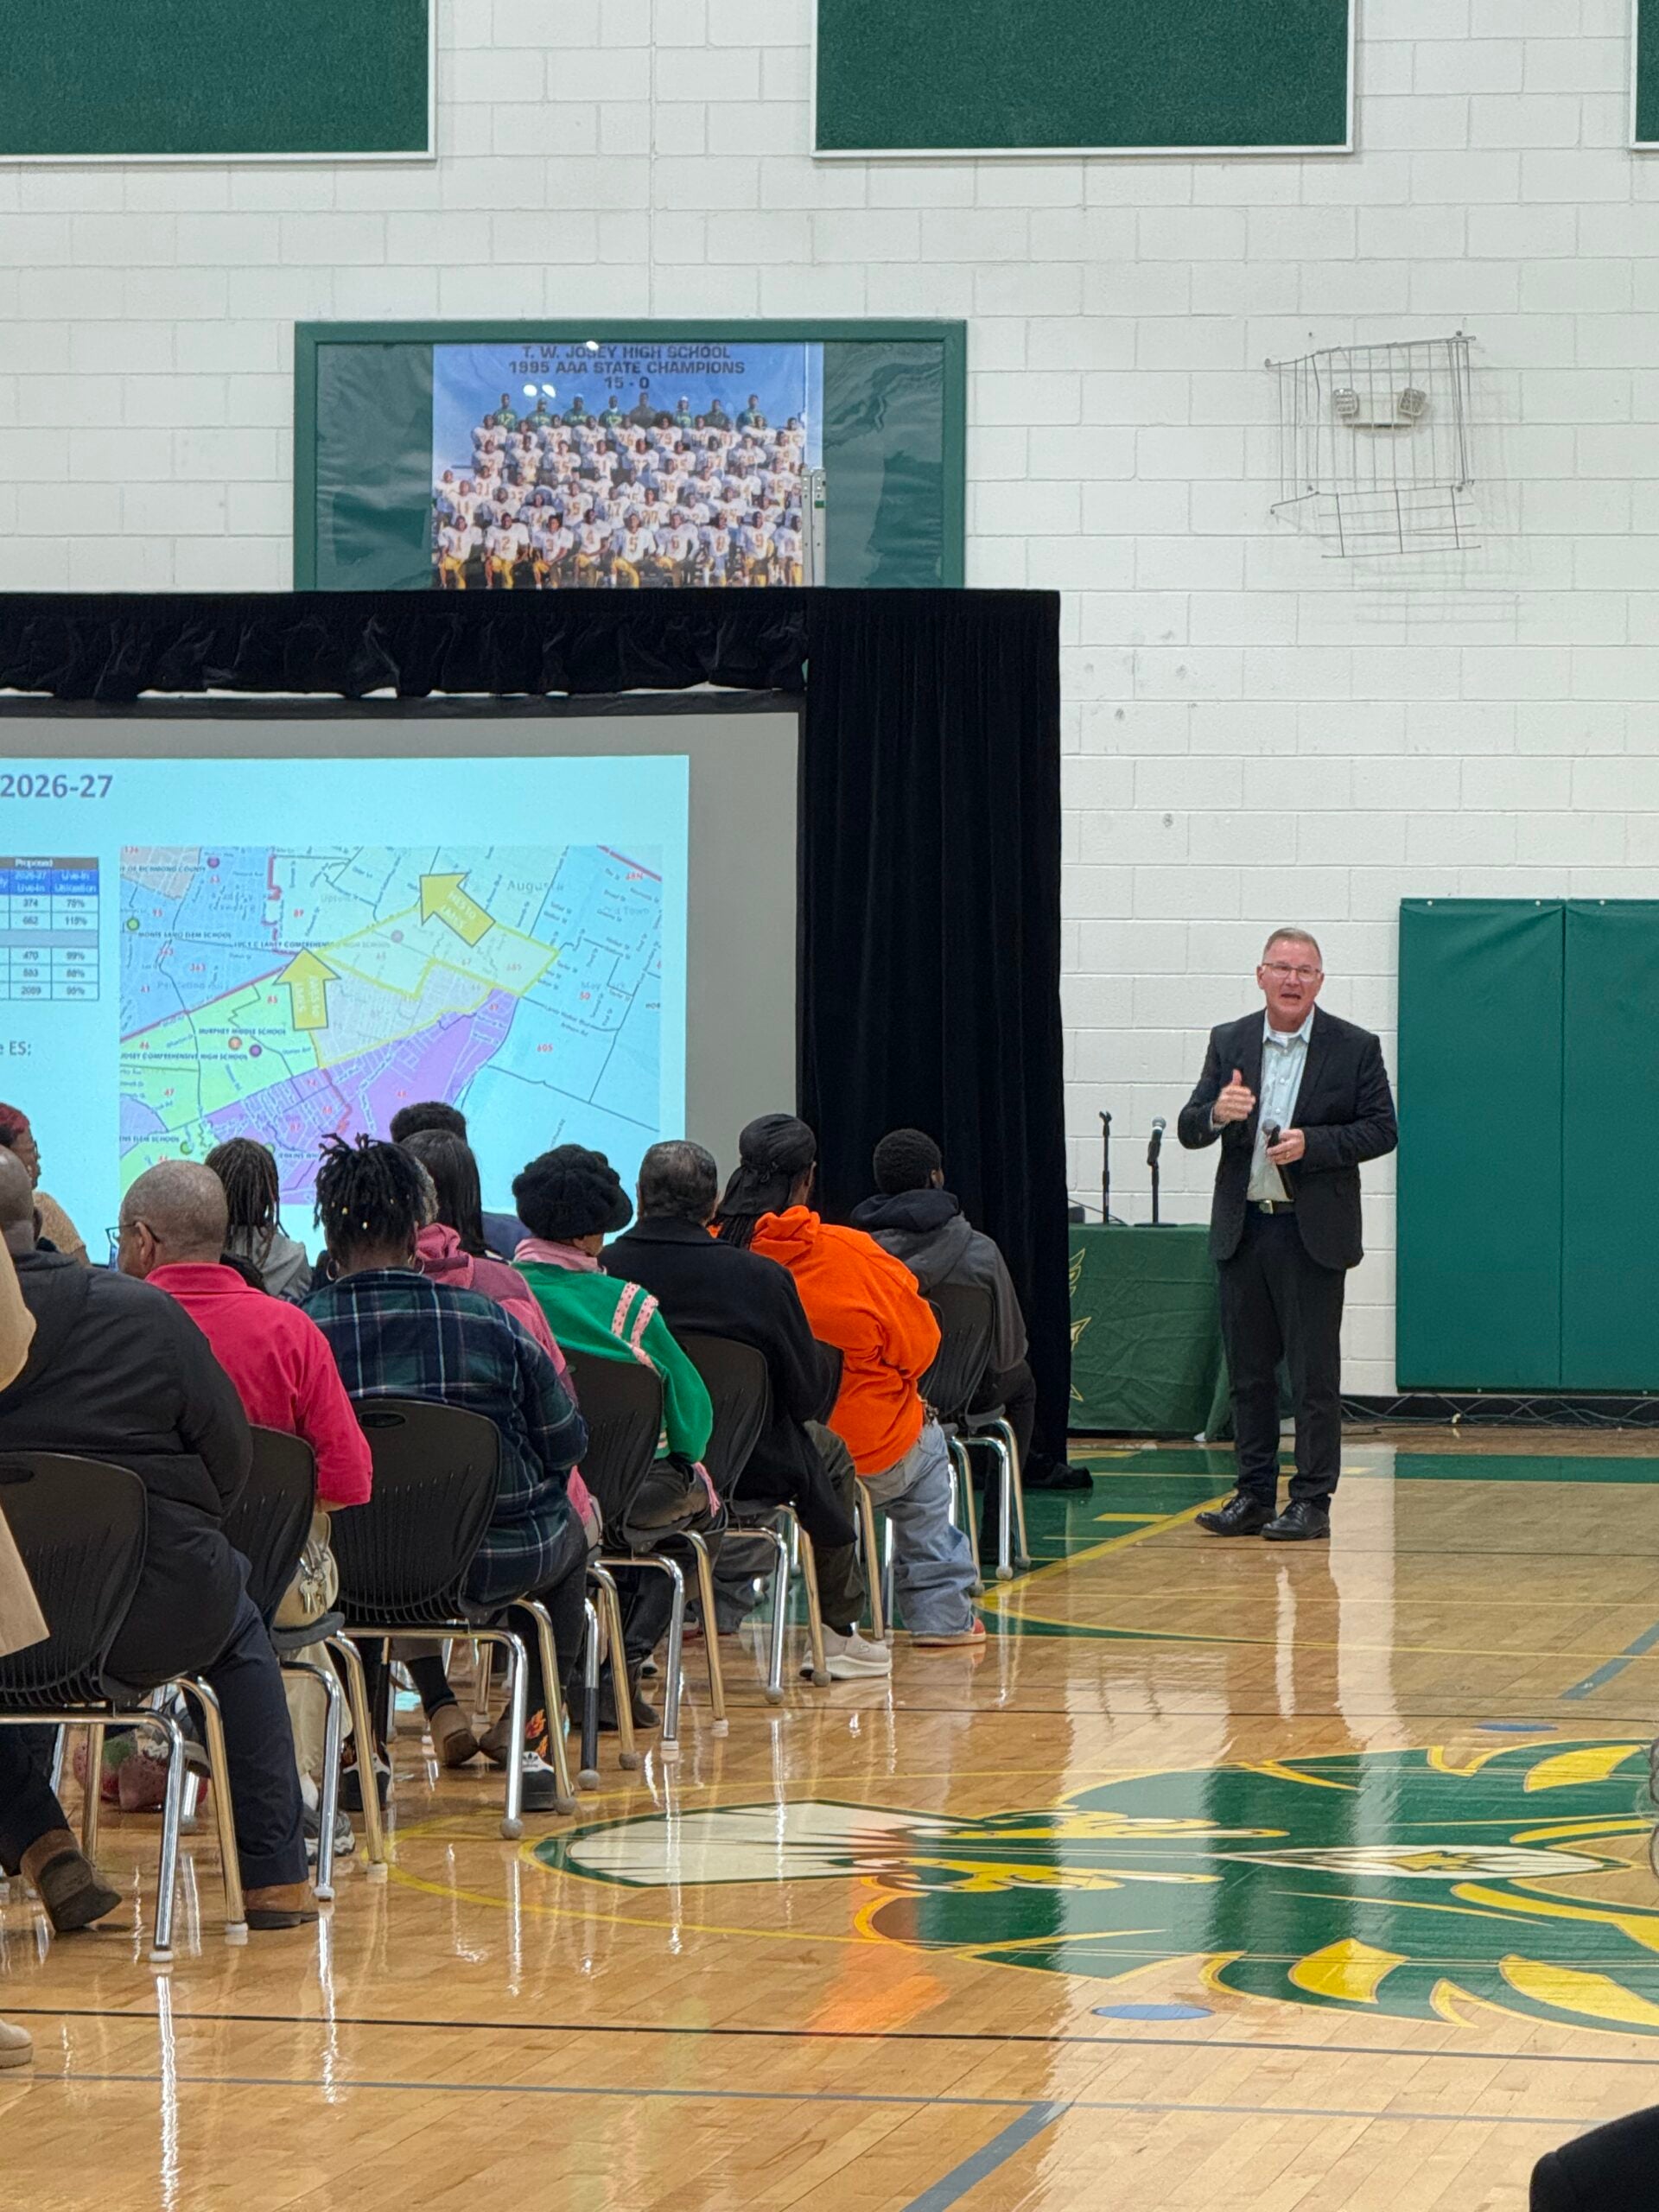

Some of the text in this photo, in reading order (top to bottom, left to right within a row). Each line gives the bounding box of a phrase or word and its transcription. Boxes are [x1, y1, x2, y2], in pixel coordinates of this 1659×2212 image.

[523, 346, 730, 359] T. W. JOSEY HIGH SCHOOL
[509, 361, 745, 374] 1995 AAA STATE CHAMPIONS
[604, 377, 624, 389] 15
[639, 377, 650, 389] 0
[0, 773, 113, 798] 2026-27
